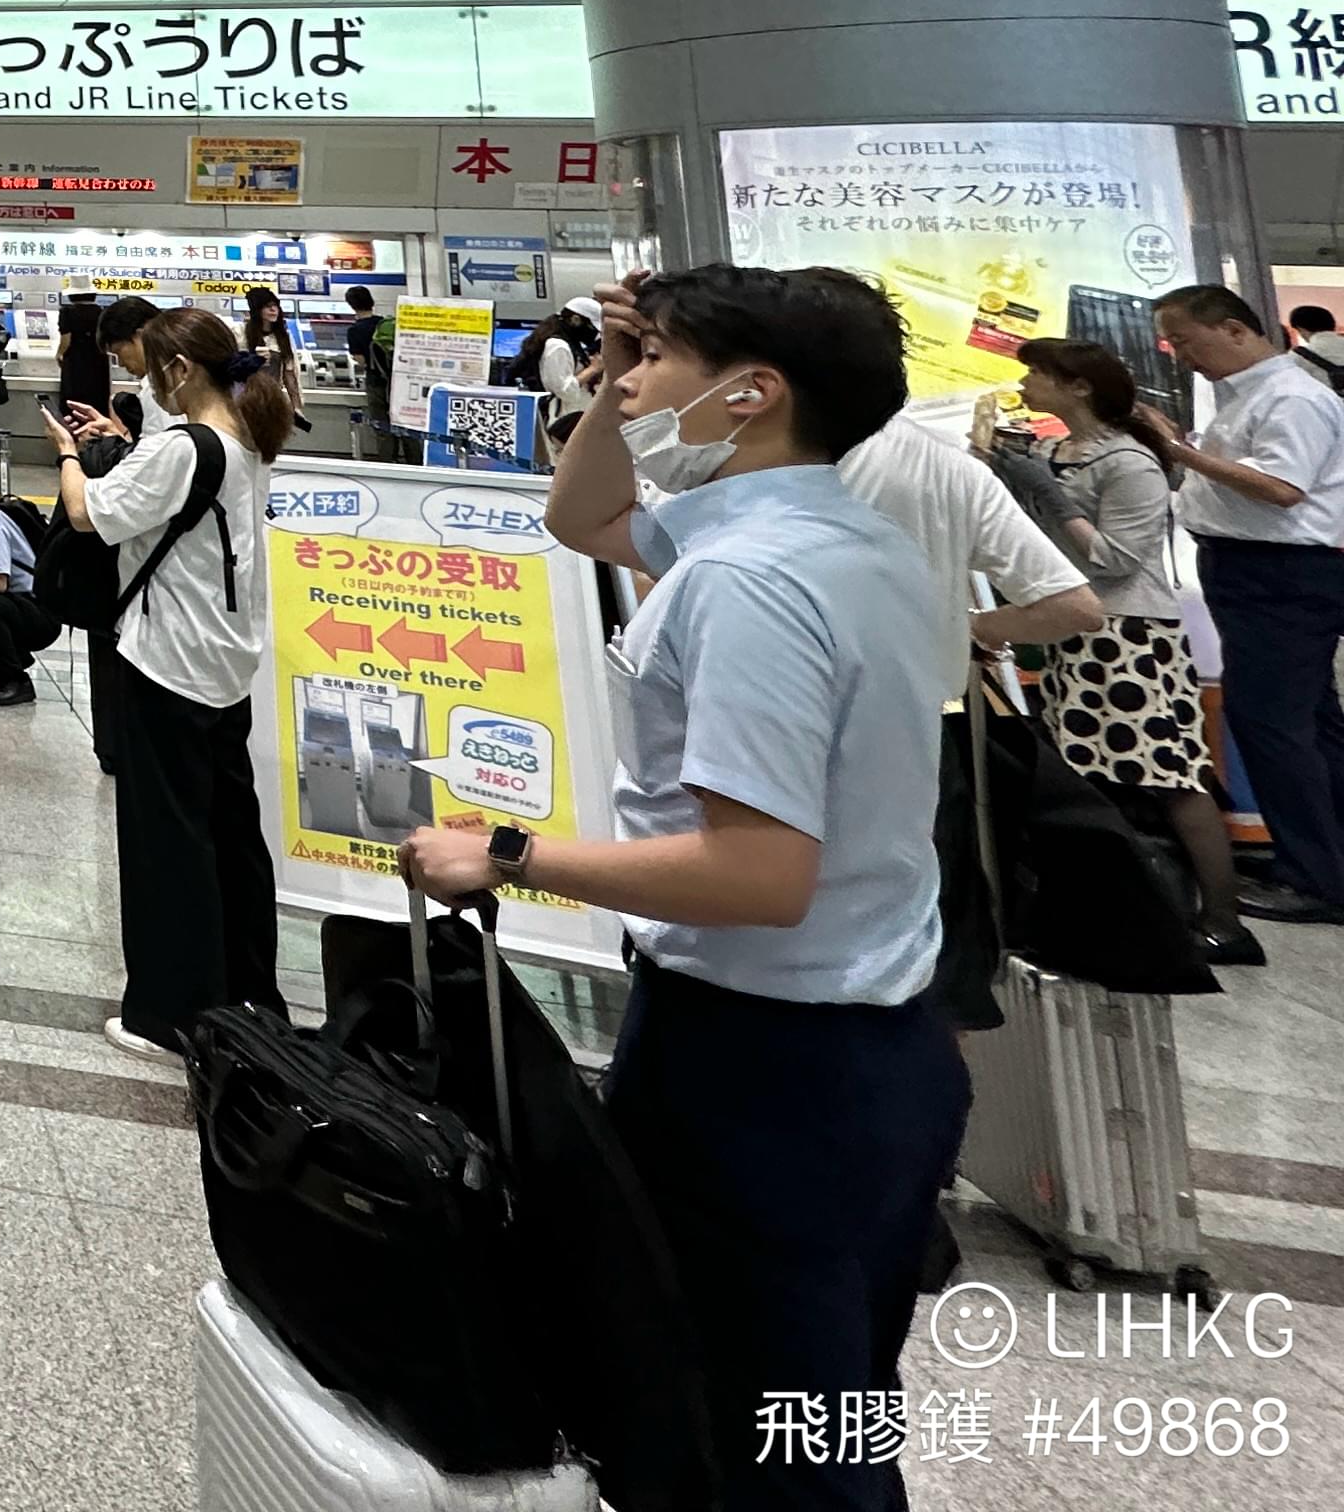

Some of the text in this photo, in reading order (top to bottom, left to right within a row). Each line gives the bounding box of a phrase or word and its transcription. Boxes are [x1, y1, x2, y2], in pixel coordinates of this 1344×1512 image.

[69, 86, 109, 110] JR
[127, 86, 196, 111] Line
[214, 86, 349, 111] Tickets
[1256, 87, 1340, 114] and
[856, 141, 988, 156] CICIBELLA
[41, 164, 101, 174] Information
[795, 214, 1087, 234] それぞれの悩みに集中ケア
[1, 241, 56, 257] 新幹線
[65, 244, 108, 257] 指定券
[181, 244, 219, 260] 本日
[13, 292, 24, 302] 4
[195, 281, 238, 294] Today
[47, 294, 57, 304] 5
[221, 298, 231, 308] 7
[444, 501, 545, 534] スマートEX
[294, 537, 521, 592] きっぷの受取
[309, 587, 522, 627] Receiving tickets
[359, 662, 483, 692] Over there
